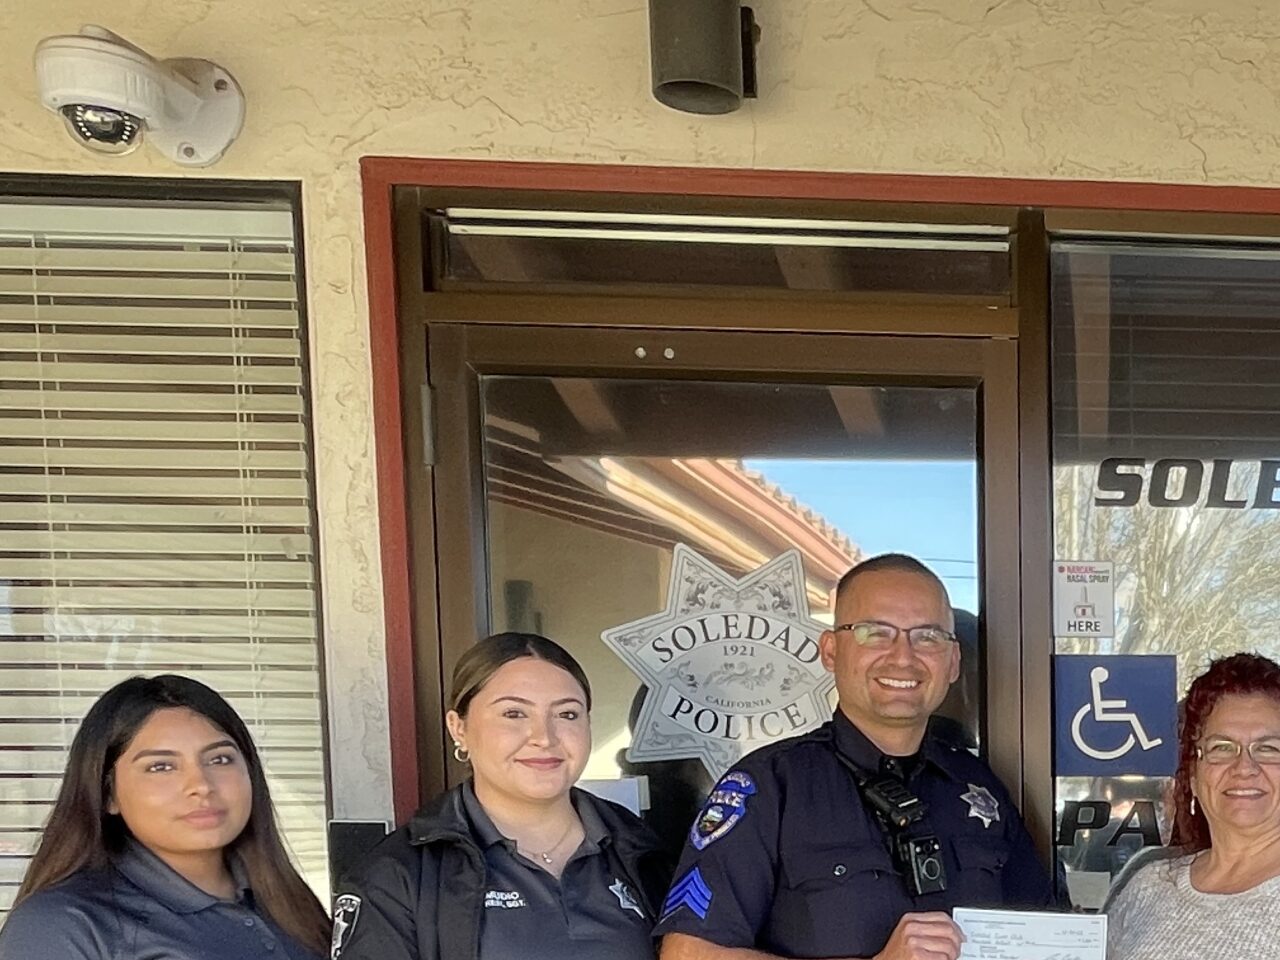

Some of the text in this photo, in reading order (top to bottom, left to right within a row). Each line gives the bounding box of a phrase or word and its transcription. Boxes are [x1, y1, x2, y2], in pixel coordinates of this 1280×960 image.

[1067, 620, 1101, 632] HERE
[651, 613, 821, 664] SOLEDAD
[722, 644, 756, 658] 1921
[704, 696, 772, 710] CALIFORNIA
[667, 696, 807, 741] POLICE
